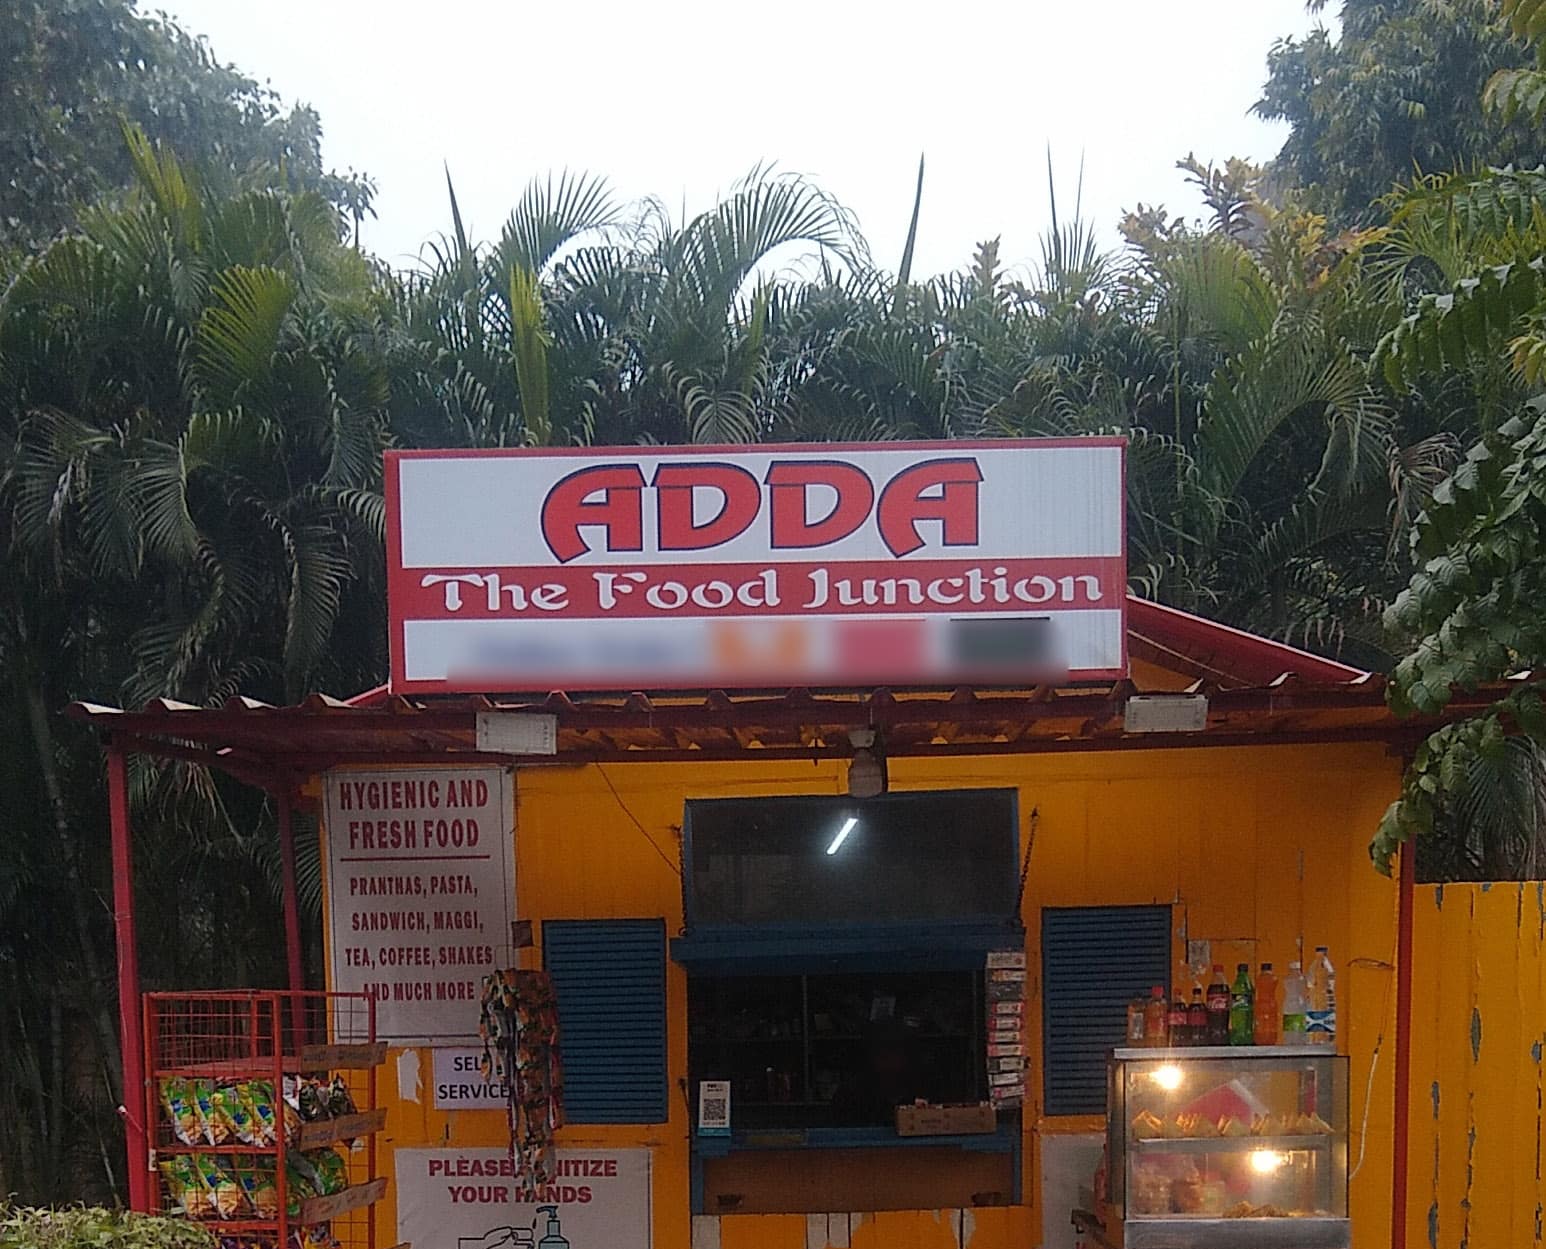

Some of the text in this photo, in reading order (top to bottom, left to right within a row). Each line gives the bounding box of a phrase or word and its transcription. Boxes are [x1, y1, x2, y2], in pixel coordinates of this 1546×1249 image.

[540, 456, 984, 564] ADDA
[421, 565, 1103, 613] The Food Junction
[340, 778, 489, 810] HYGIENIC AND
[349, 818, 479, 850] FRESH FOOD
[350, 875, 478, 898] PRANTHAS, PASTA,
[352, 910, 484, 934] SANDWICH, MAGGI,
[345, 945, 493, 969] TEA, COFFEE, SHAKES
[393, 982, 432, 1000] MUCH
[436, 980, 475, 1000] MORE
[454, 1056, 484, 1072] SEL
[448, 1186, 508, 1204] YOUR
